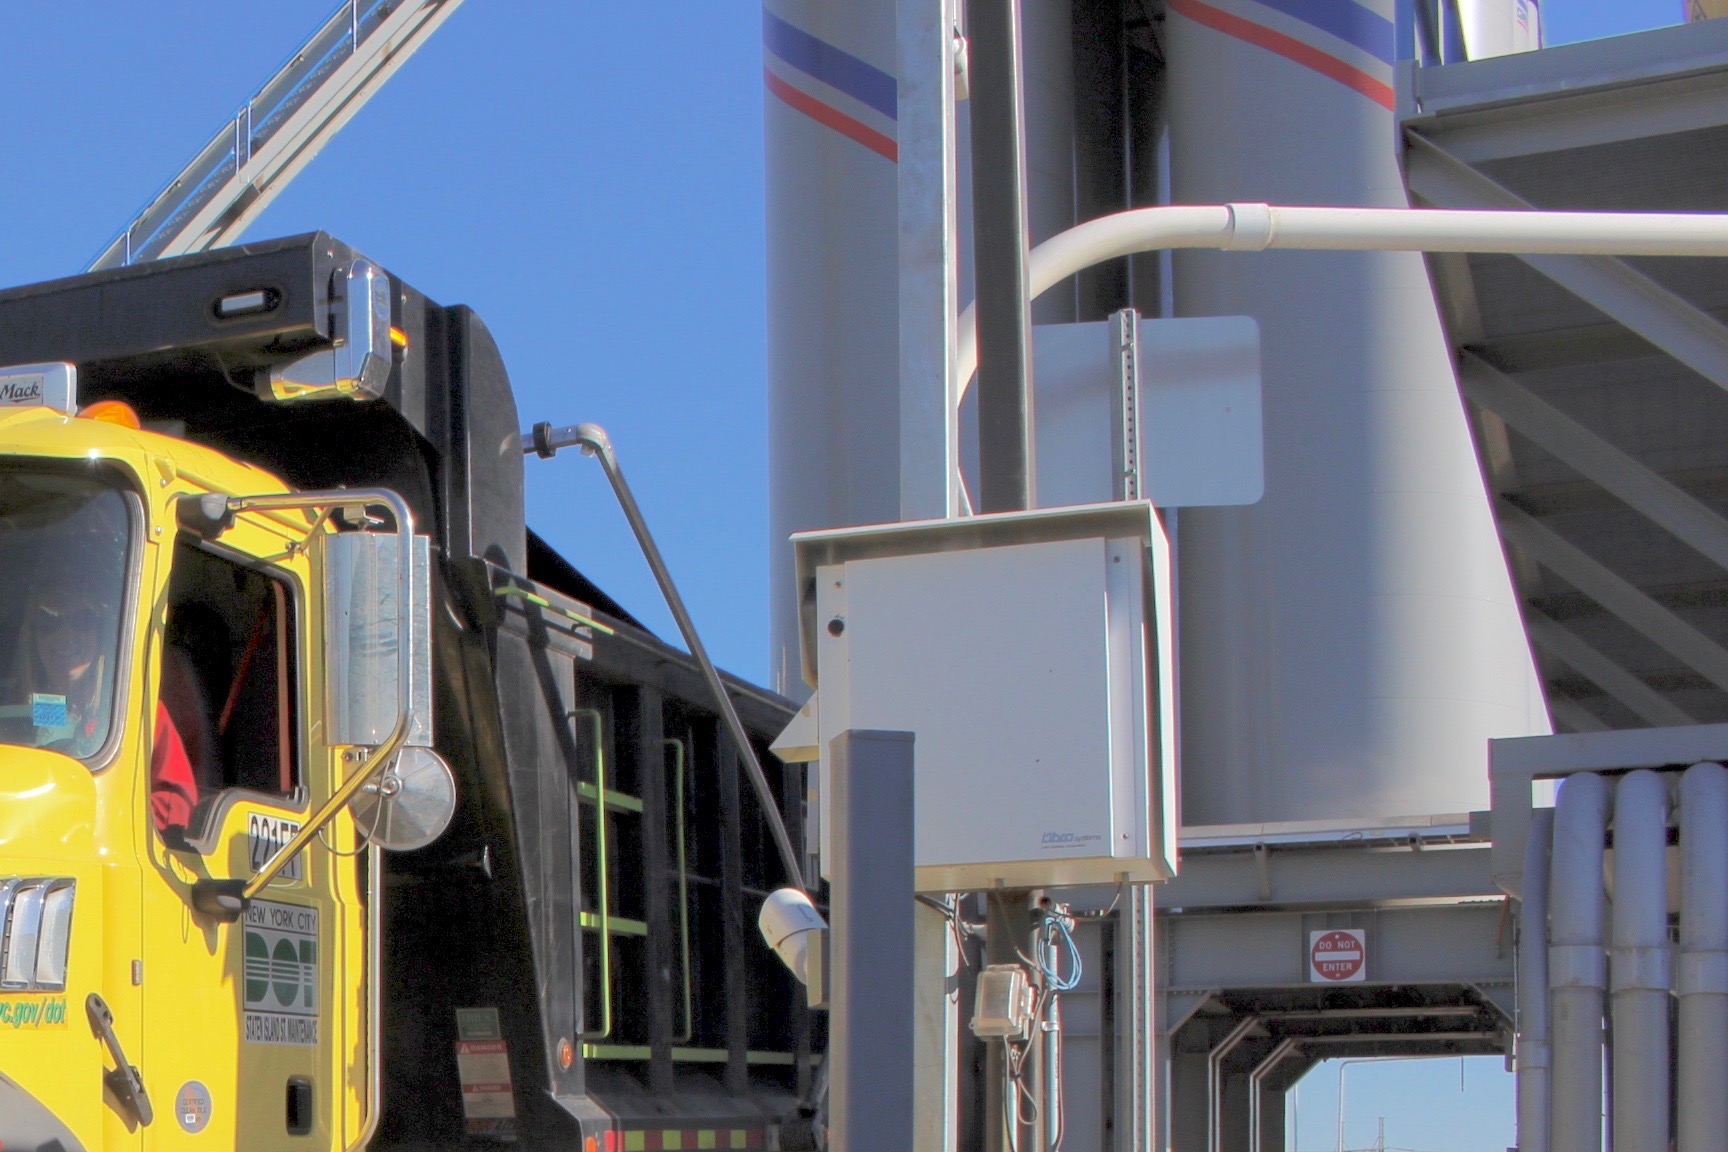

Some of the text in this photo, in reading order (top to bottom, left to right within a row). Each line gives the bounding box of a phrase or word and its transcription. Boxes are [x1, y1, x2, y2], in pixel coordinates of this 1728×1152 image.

[245, 905, 317, 931] NEW YORK CITY
[1337, 941, 1356, 949] NOT
[246, 931, 317, 1008] DOT
[1323, 963, 1352, 971] ENTER
[264, 1016, 279, 1042] ISLAND
